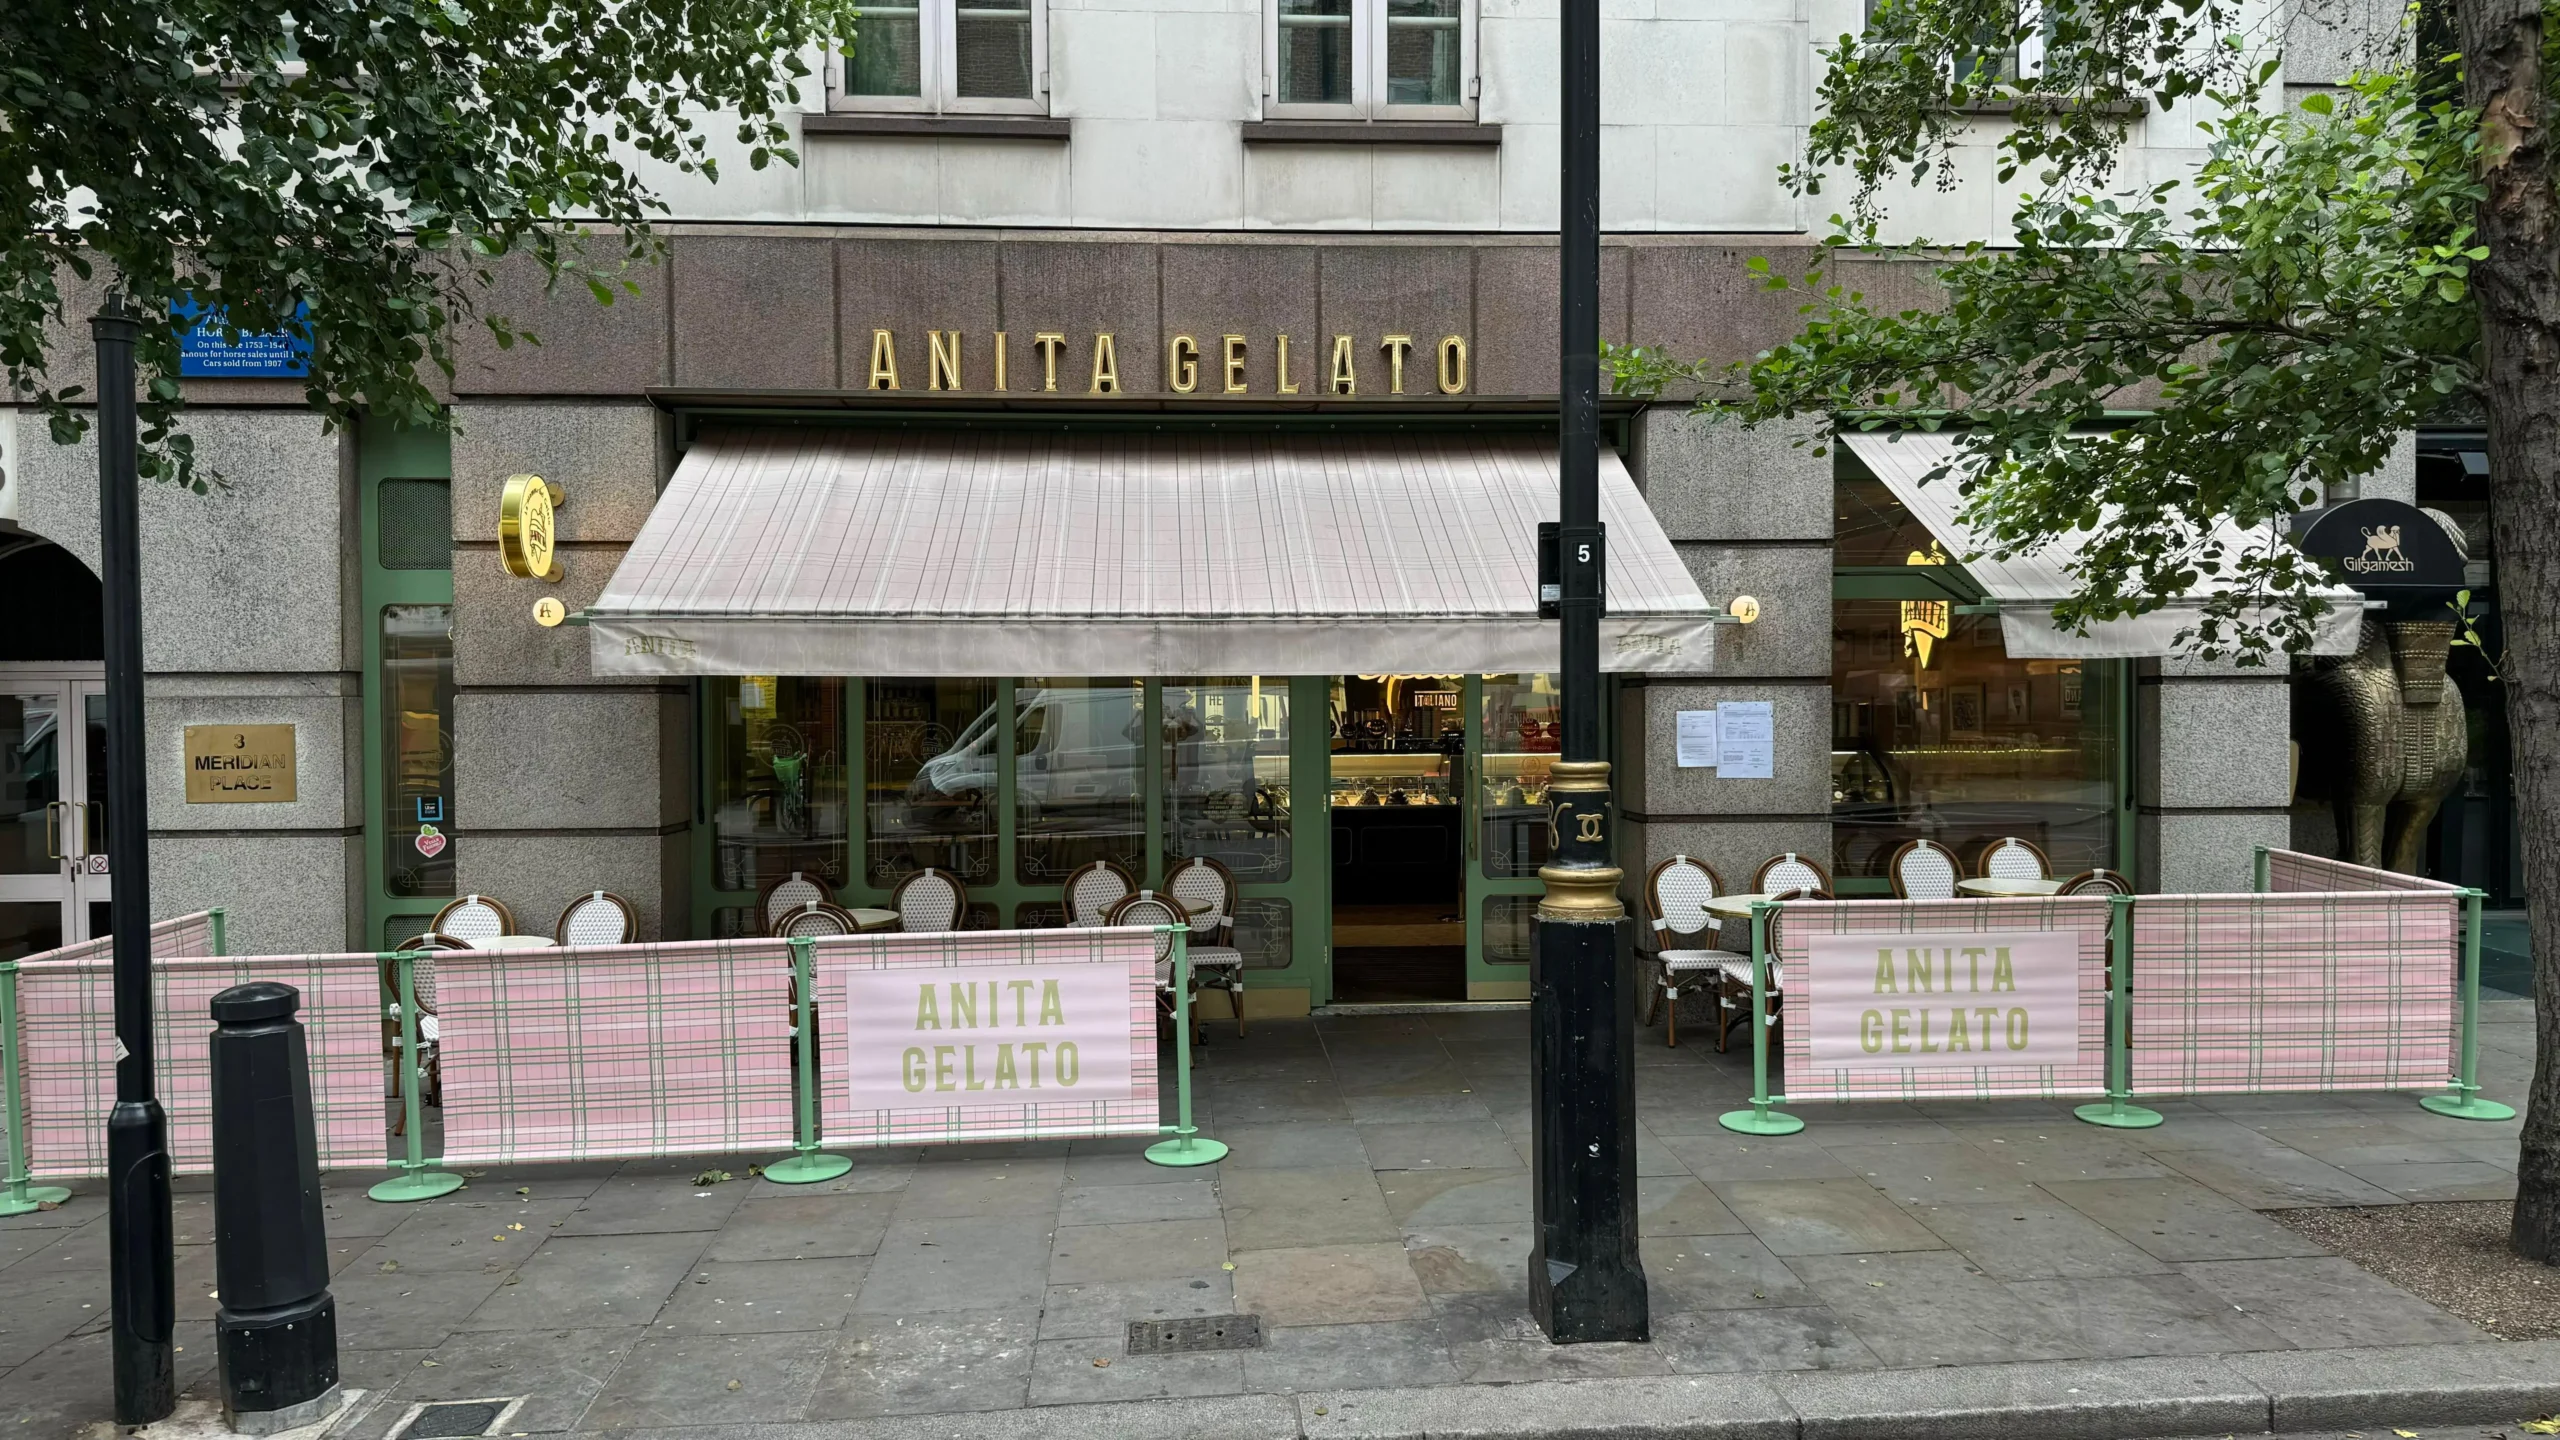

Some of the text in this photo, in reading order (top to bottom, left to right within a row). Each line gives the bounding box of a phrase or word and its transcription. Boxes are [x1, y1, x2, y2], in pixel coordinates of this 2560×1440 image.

[197, 328, 236, 337] HOR
[197, 341, 210, 349] On
[211, 341, 226, 349] this
[210, 350, 222, 358] for
[223, 350, 246, 358] horse
[247, 350, 268, 358] sales
[269, 350, 289, 358] until
[868, 329, 1468, 395] ANITA GELATO
[223, 359, 241, 367] sold
[242, 359, 263, 367] from
[1577, 544, 1591, 562] 5
[2343, 556, 2414, 574] Gilgamesh
[1903, 600, 1946, 631] ANITA
[1414, 694, 1457, 707] ITALIANO
[233, 733, 246, 749] 3
[195, 754, 286, 771] MERIDIAN
[210, 775, 272, 791] PLACE
[1872, 946, 2017, 994] ANITA
[914, 979, 1065, 1031] ANITA
[1860, 1006, 2029, 1054] GELATO
[901, 1040, 1080, 1093] GELATO
